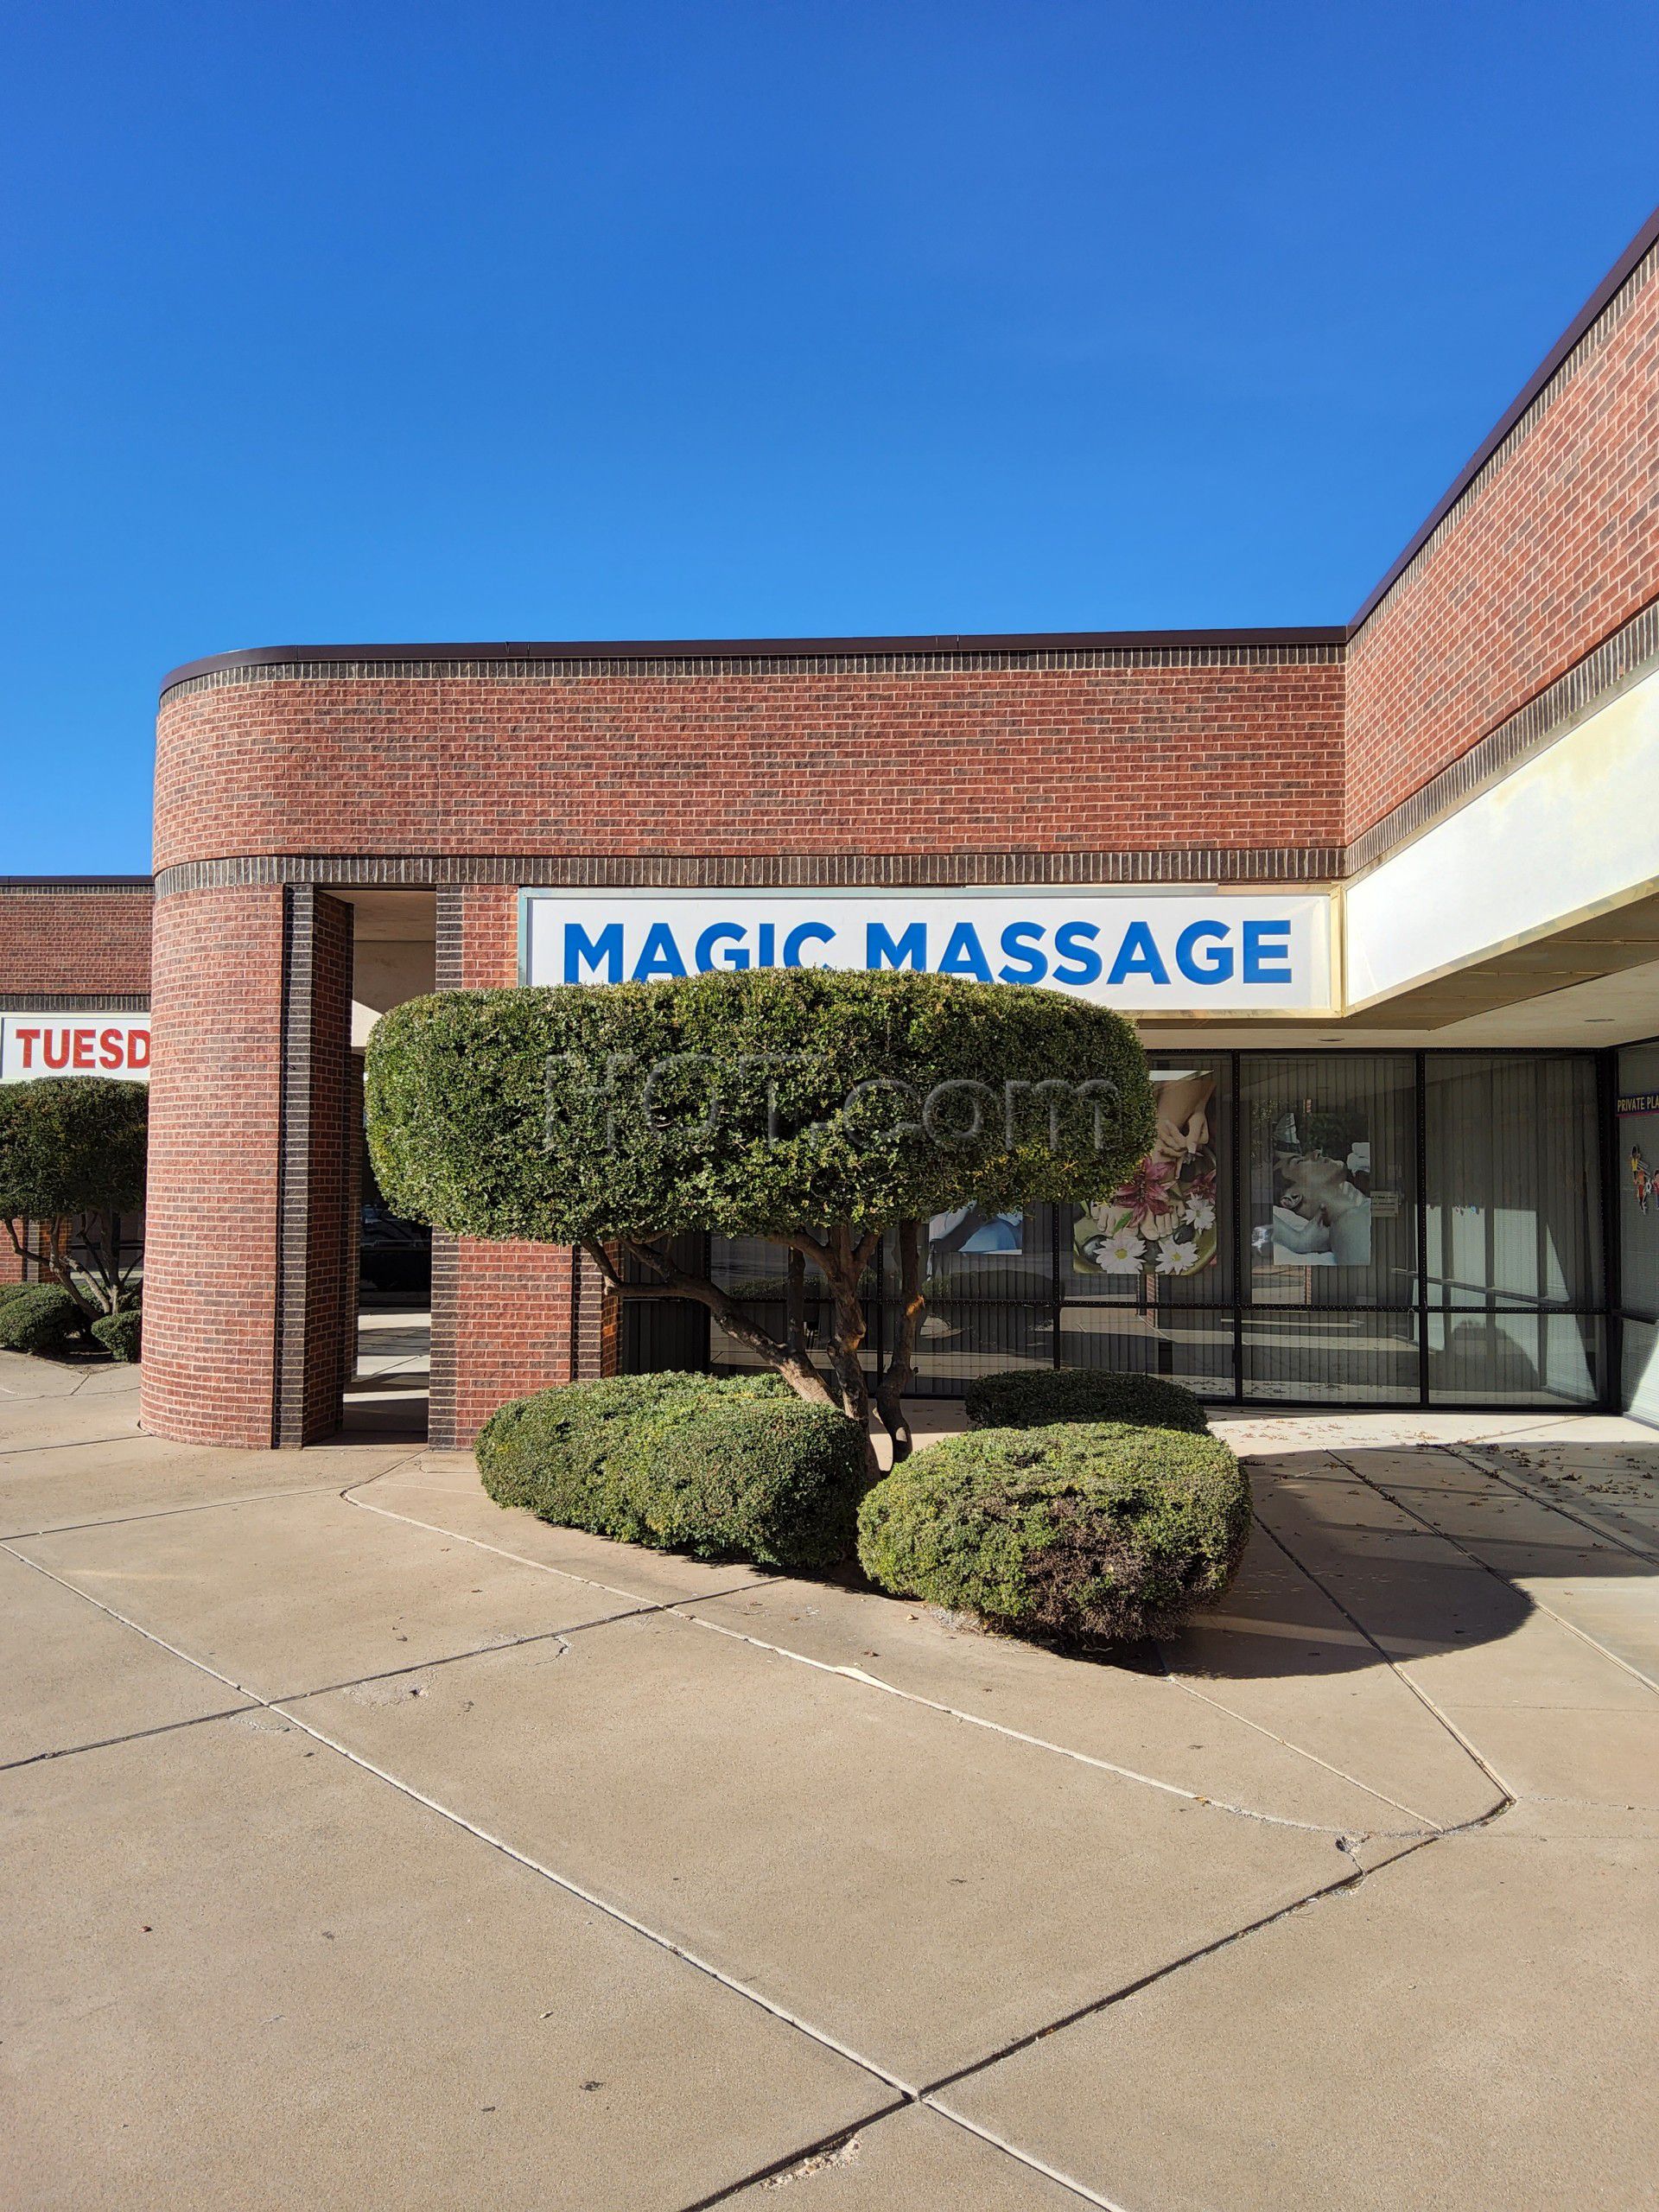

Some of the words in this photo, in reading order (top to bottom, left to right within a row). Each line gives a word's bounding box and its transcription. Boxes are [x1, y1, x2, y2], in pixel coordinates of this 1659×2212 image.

[564, 921, 836, 982] MAGIC
[867, 920, 1292, 985] MASSAGE
[16, 1028, 150, 1070] TUESD
[1618, 1096, 1645, 1112] PRIVATE
